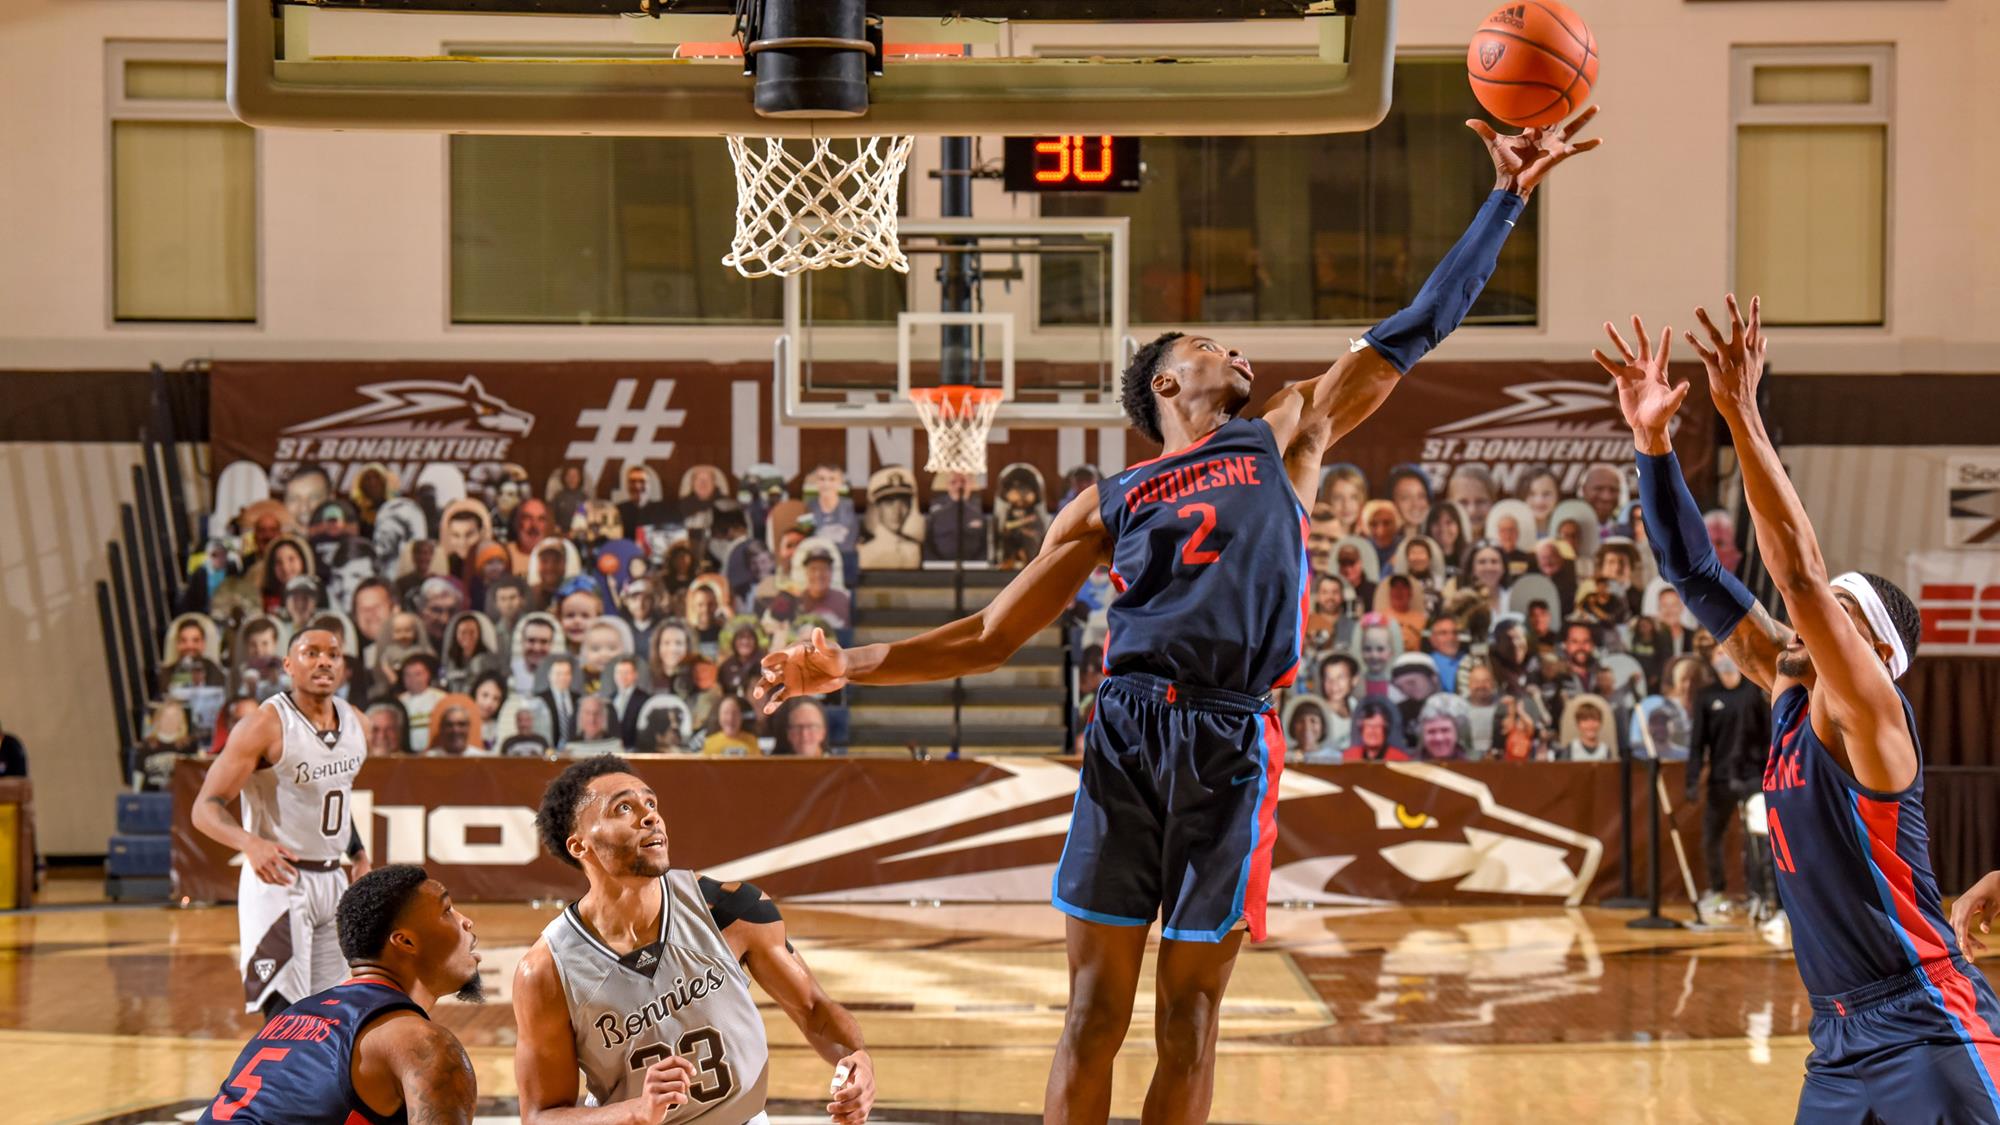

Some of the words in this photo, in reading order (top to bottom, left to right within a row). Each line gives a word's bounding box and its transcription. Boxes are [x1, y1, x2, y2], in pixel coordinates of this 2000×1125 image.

[1036, 135, 1112, 182] 30
[1125, 456, 1261, 513] DUQUESNE
[1177, 503, 1219, 565] 2
[321, 790, 344, 837] 0
[594, 967, 725, 1049] Bonnies
[211, 1047, 292, 1121] 5
